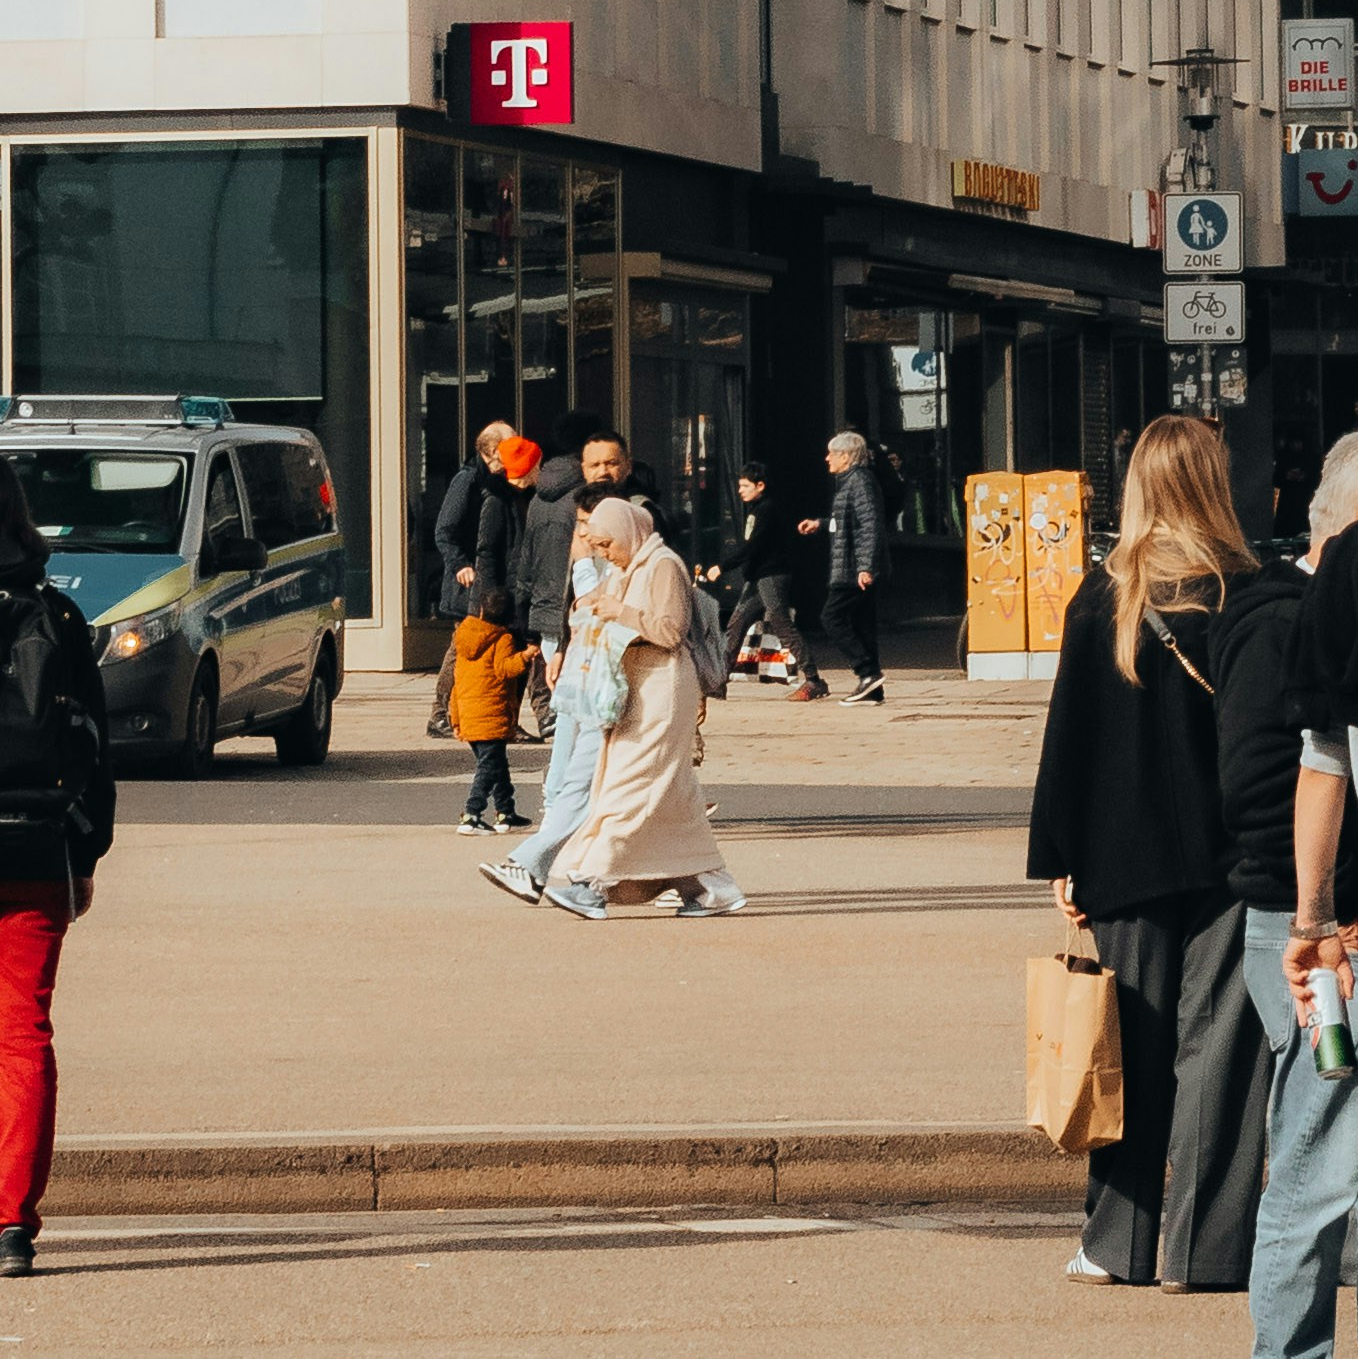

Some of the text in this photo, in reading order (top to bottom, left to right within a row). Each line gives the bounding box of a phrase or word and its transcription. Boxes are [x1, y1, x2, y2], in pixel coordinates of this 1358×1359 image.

[1301, 61, 1330, 75] DIE
[1288, 78, 1348, 93] BRILLE
[1184, 254, 1222, 267] ZONE
[1193, 322, 1217, 335] frei
